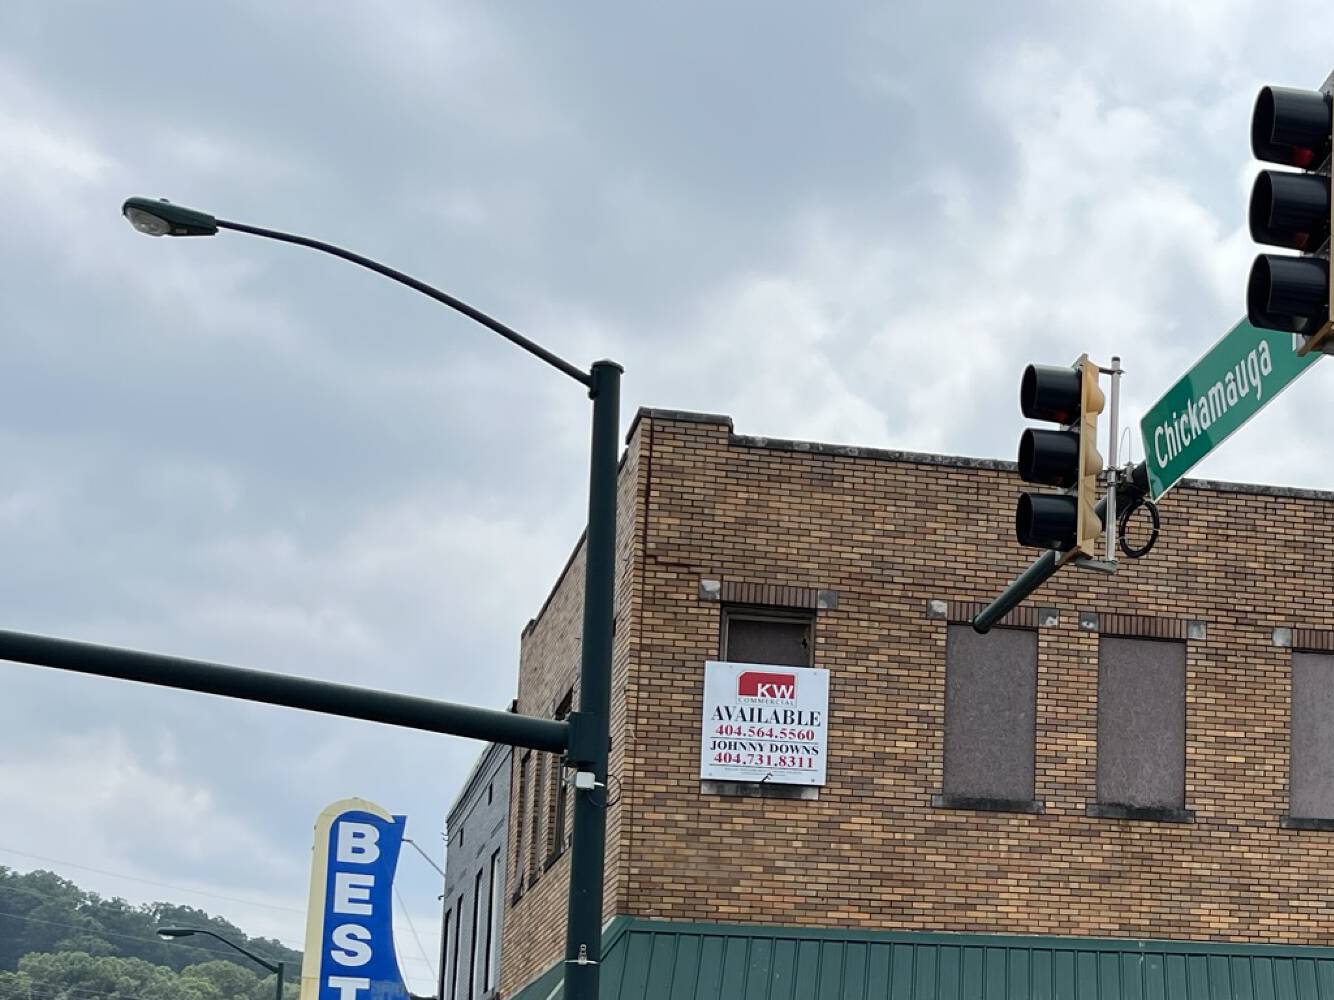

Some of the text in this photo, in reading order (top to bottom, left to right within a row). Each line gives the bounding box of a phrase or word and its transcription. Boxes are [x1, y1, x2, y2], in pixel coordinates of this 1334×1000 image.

[1153, 339, 1273, 469] Chickamauga
[757, 683, 794, 699] KW
[711, 705, 821, 727] AVAILABLE
[715, 724, 815, 741] 404.564.5560
[710, 740, 819, 756] JOHNNY DOWNS
[714, 752, 814, 769] 404.731.8311
